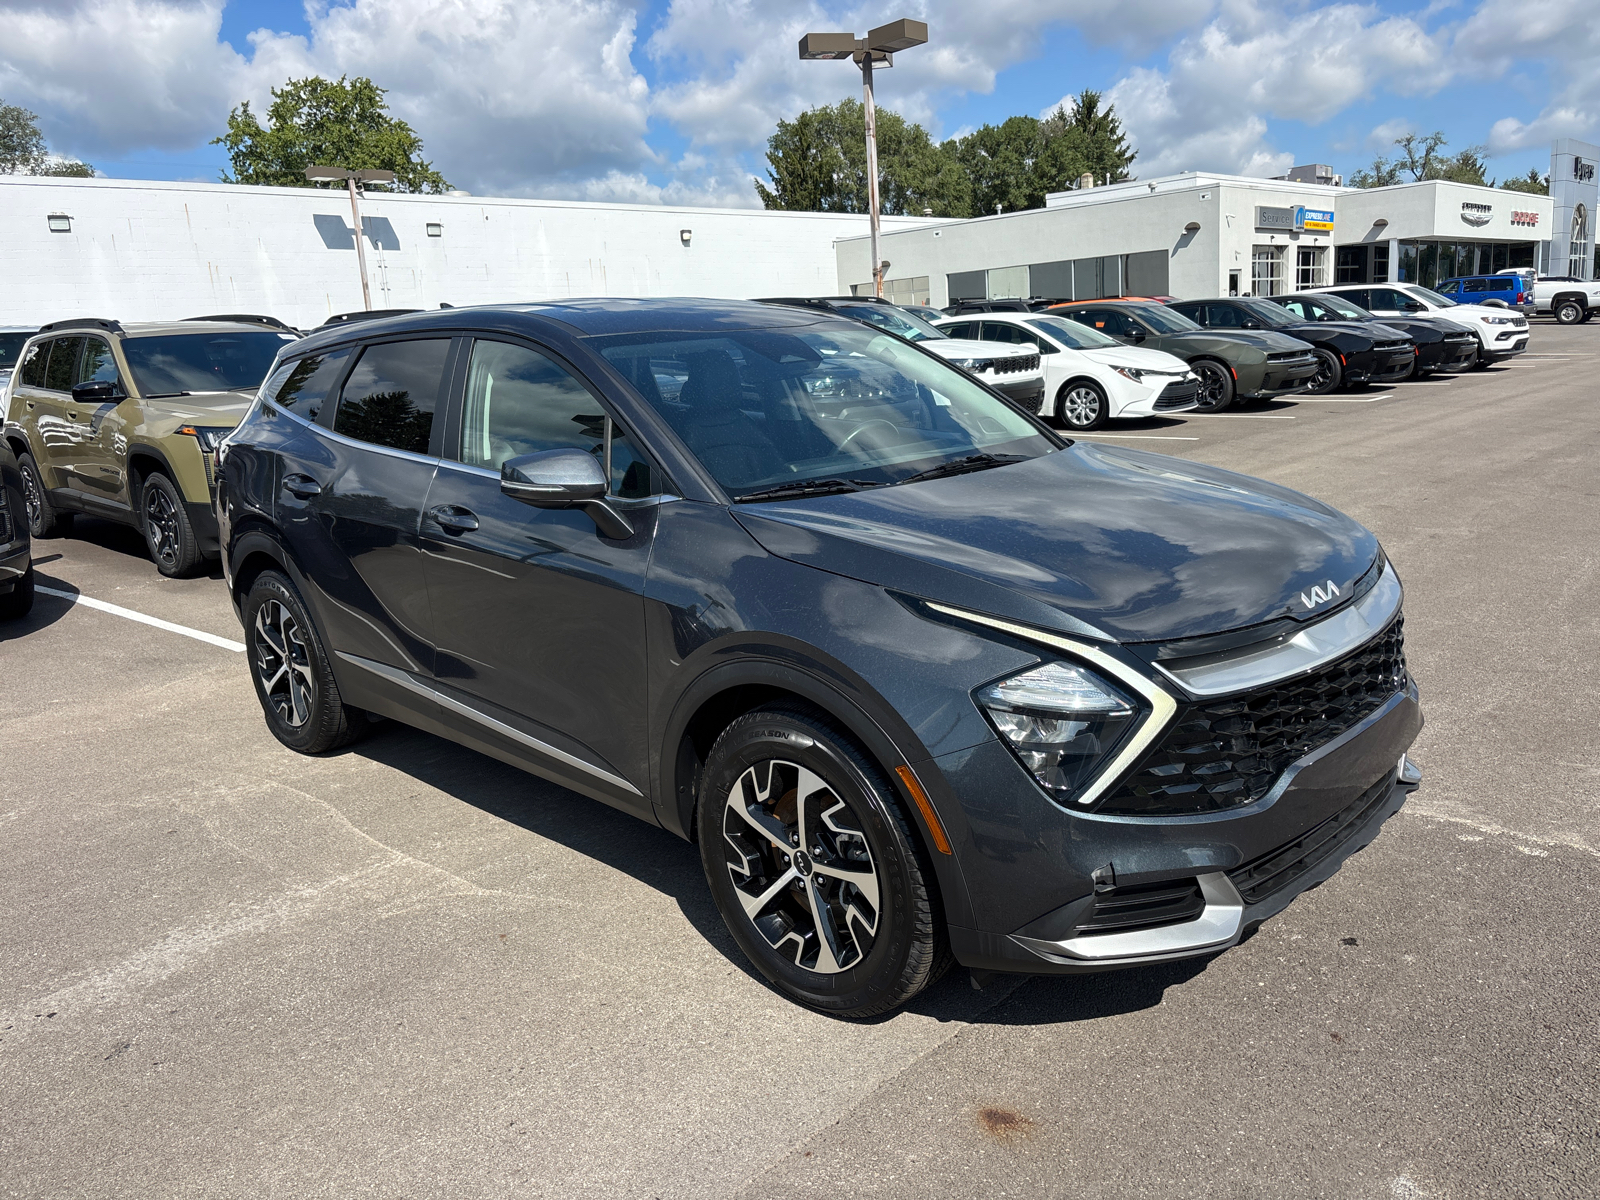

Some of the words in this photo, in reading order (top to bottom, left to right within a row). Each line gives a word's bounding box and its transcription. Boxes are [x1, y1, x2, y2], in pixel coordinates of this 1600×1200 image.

[1262, 211, 1290, 224] Service
[1513, 210, 1540, 224] DODGE
[1300, 579, 1340, 609] KIA
[747, 728, 790, 740] SEASON
